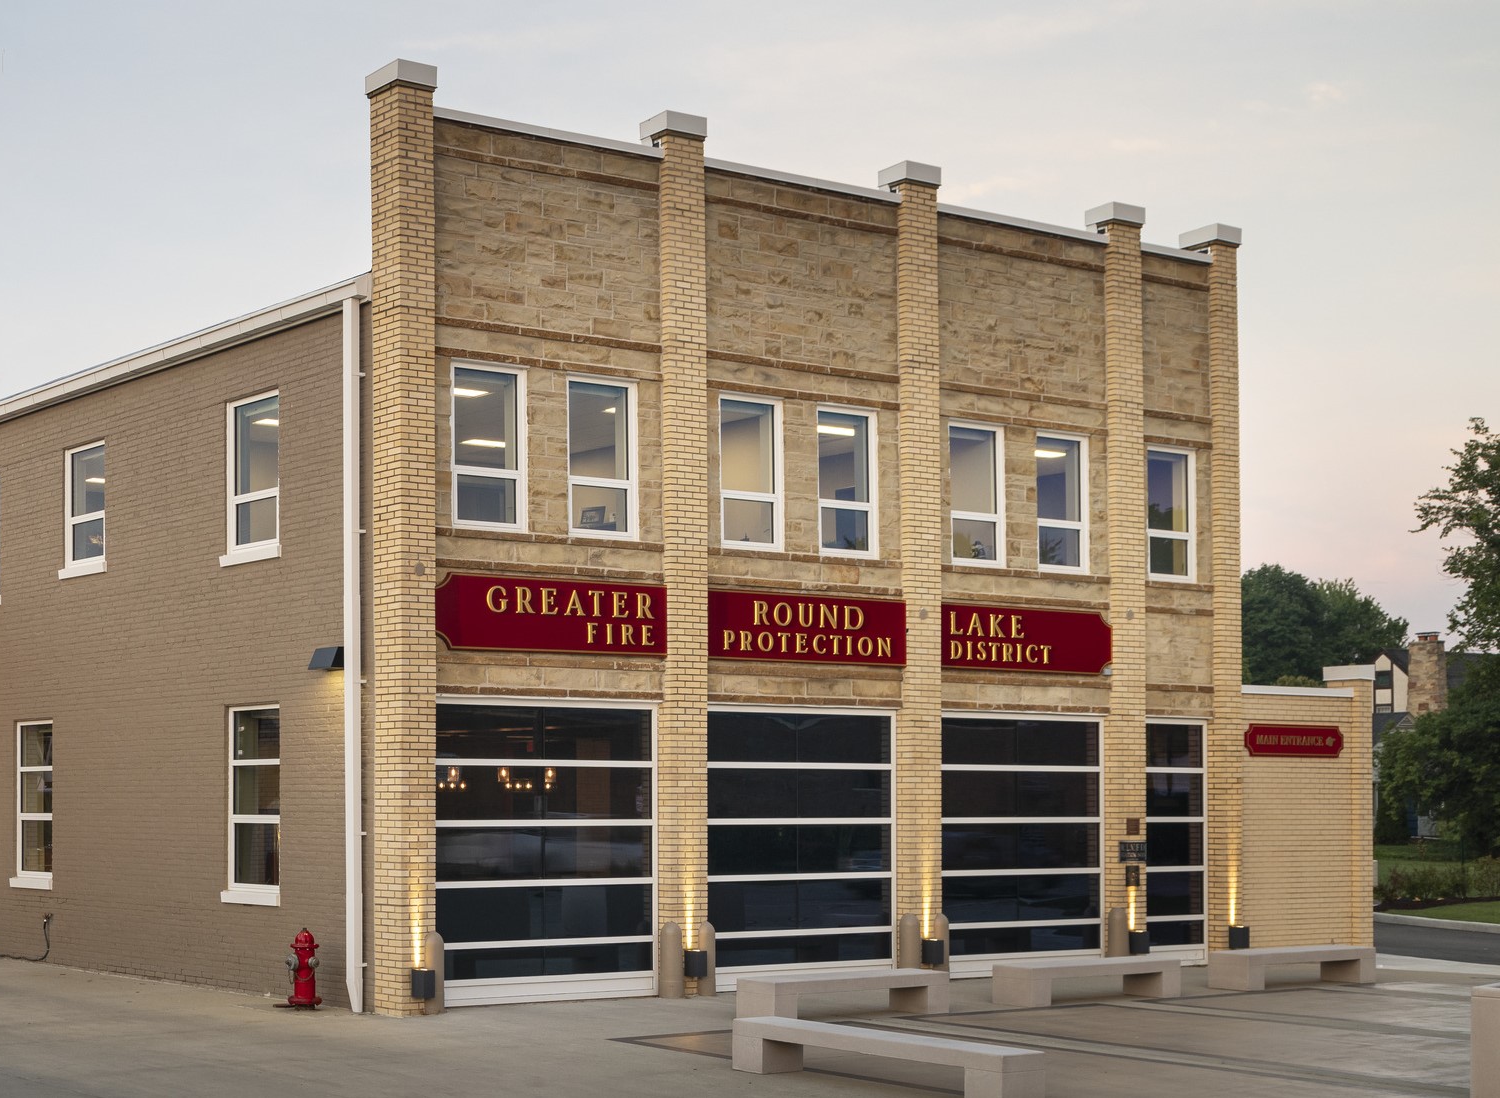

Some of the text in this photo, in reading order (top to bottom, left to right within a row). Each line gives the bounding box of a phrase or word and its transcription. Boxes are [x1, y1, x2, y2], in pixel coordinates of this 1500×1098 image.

[486, 585, 655, 619] GREATER
[753, 600, 864, 630] ROUND
[587, 622, 655, 646] FIRE
[950, 611, 1025, 639] LAKE
[723, 629, 892, 658] PROTECTION
[950, 640, 1052, 664] DISTRICT
[1256, 734, 1324, 747] MAIN ENTRANCE
